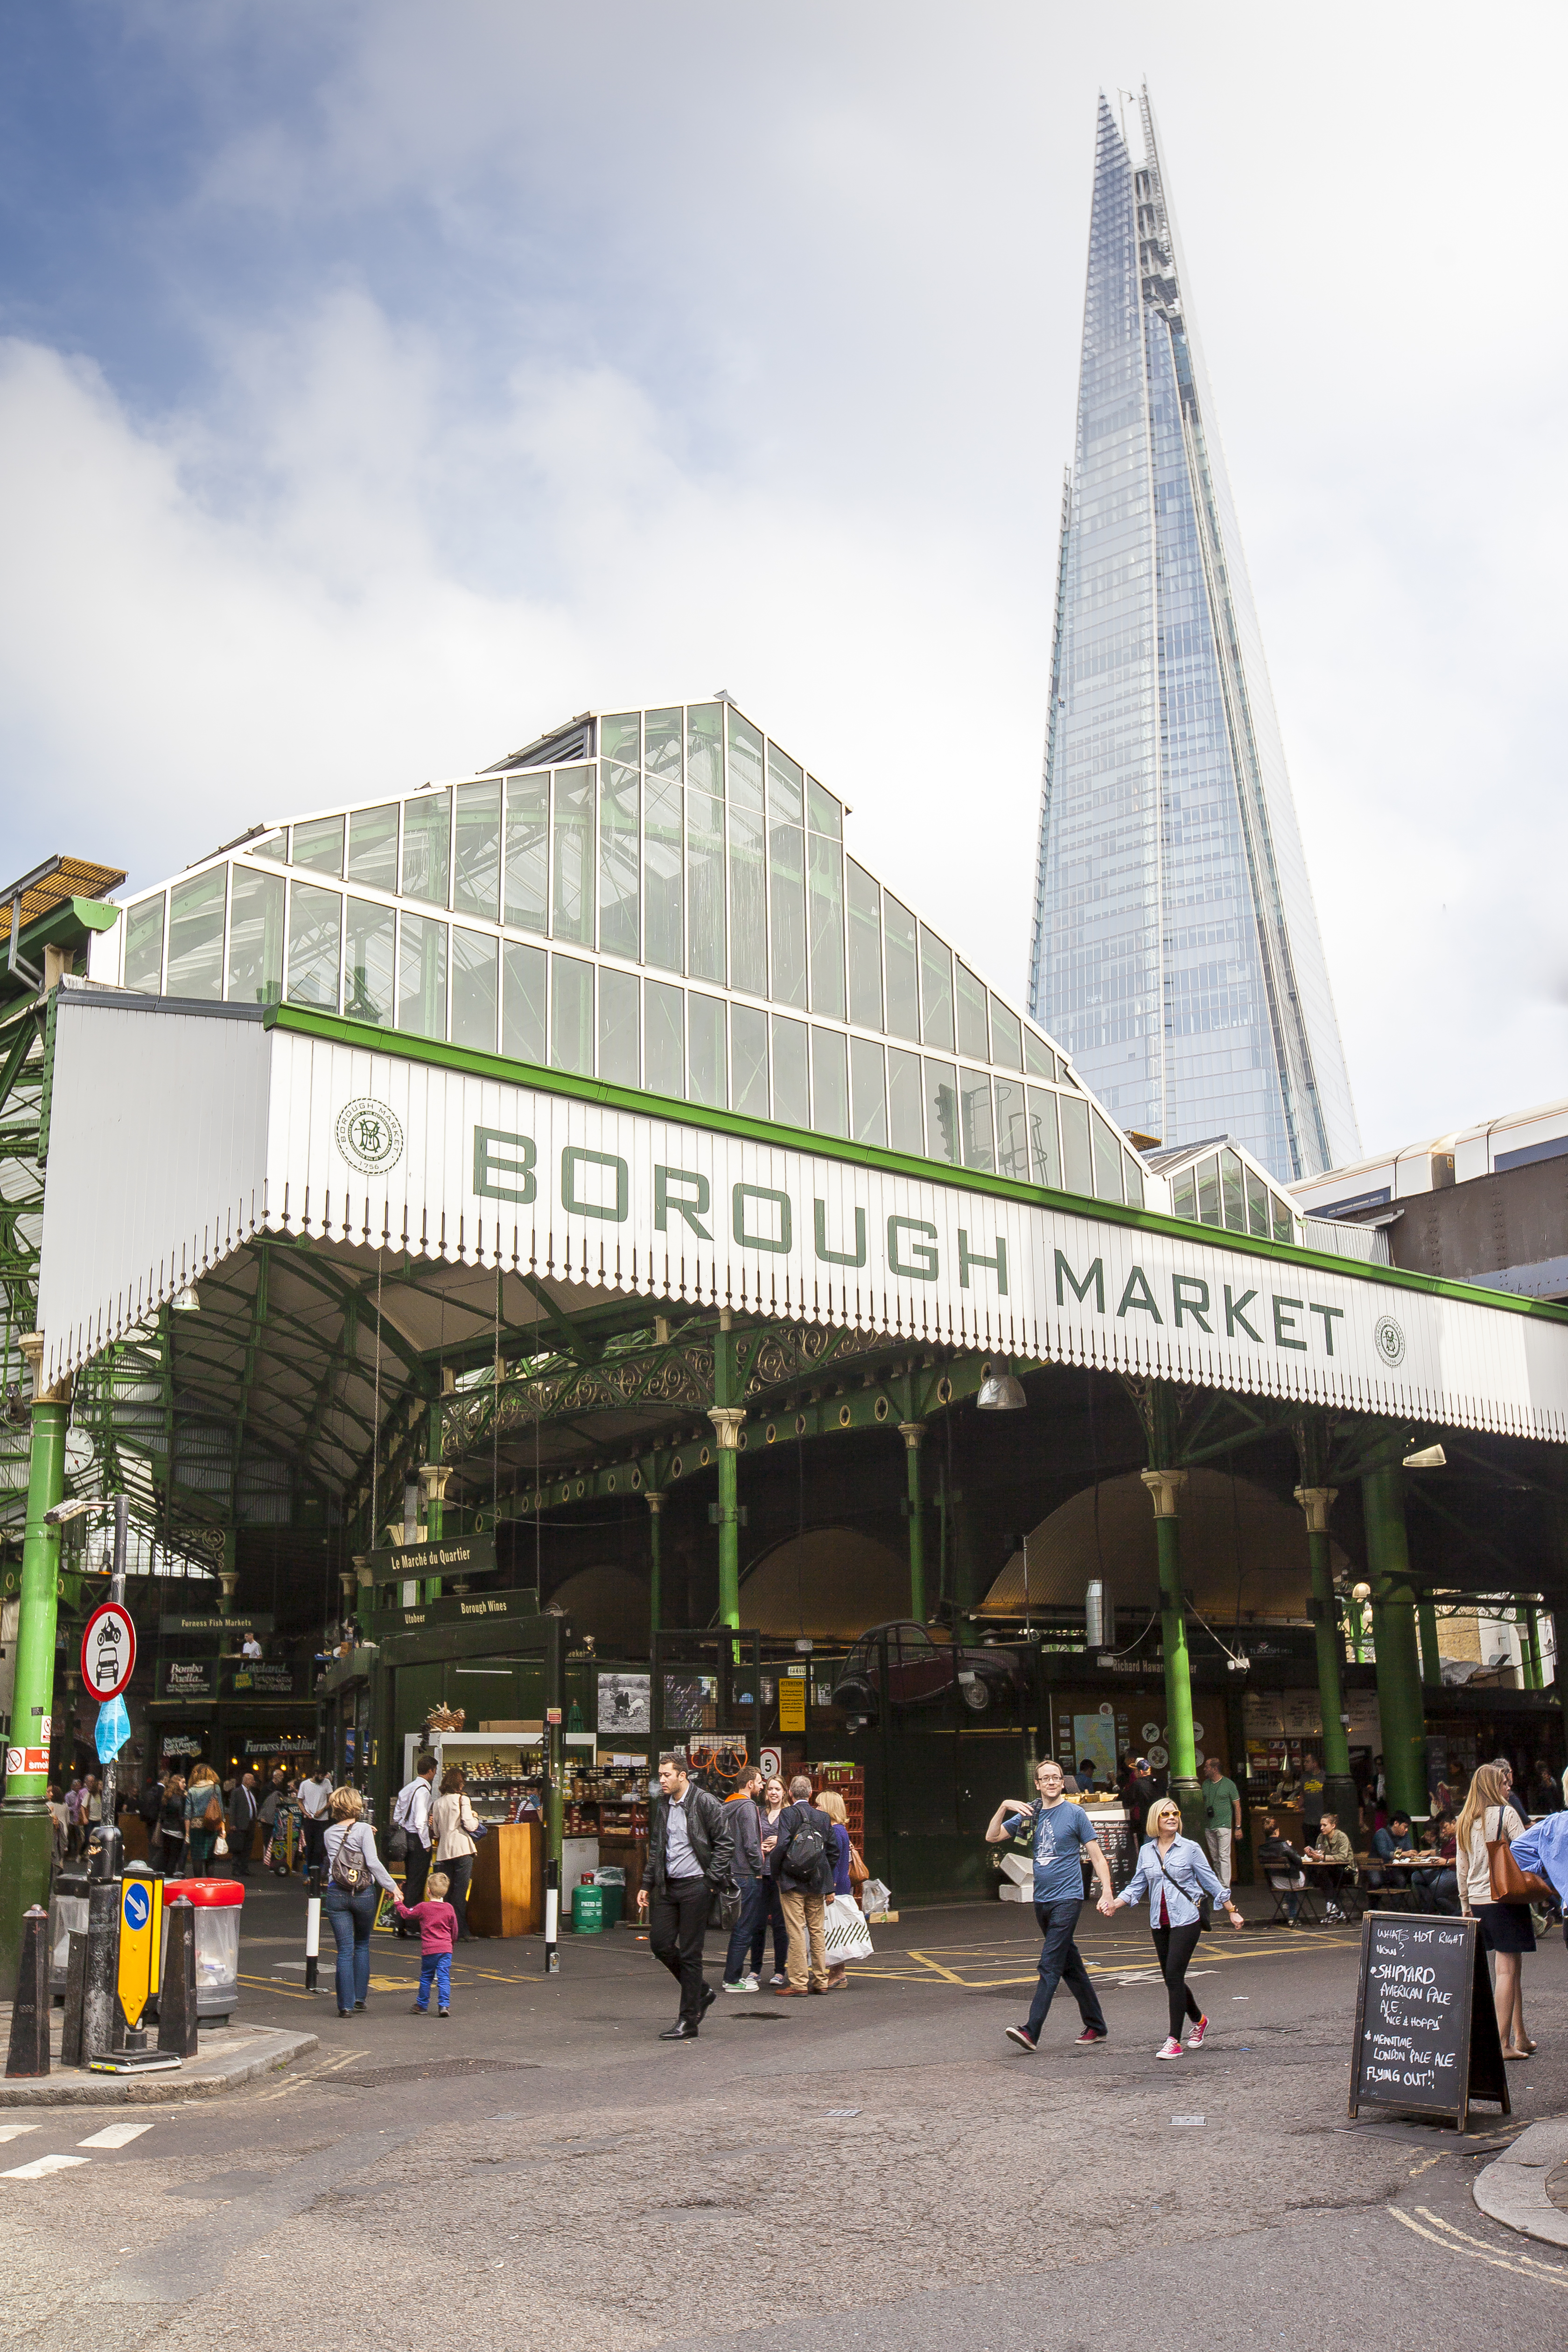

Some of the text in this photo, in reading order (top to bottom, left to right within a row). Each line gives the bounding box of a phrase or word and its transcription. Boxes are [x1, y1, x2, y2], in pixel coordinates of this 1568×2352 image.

[340, 1103, 399, 1153] BOROUGH MARKET
[360, 1161, 379, 1169] 1756
[473, 1125, 1344, 1356] BOROUGH MARKET
[1377, 1319, 1404, 1352] BOROUGH MARKET
[391, 1547, 470, 1570] Le Marché du Quartier
[461, 1600, 507, 1614] Borough Wines
[405, 1613, 425, 1624] Utobeer
[170, 1663, 203, 1673] Bomba
[764, 1759, 771, 1772] 5
[1413, 1930, 1435, 1943] HOT
[1438, 1932, 1465, 1946] RIGHT
[1380, 1982, 1453, 2005] AMERICAN PALE
[1402, 2016, 1409, 2026] &
[1373, 2034, 1413, 2049] MEANTIME
[1373, 2047, 1405, 2061] LONDON
[1409, 2049, 1432, 2064] PALE
[1366, 2066, 1400, 2082] FLYING
